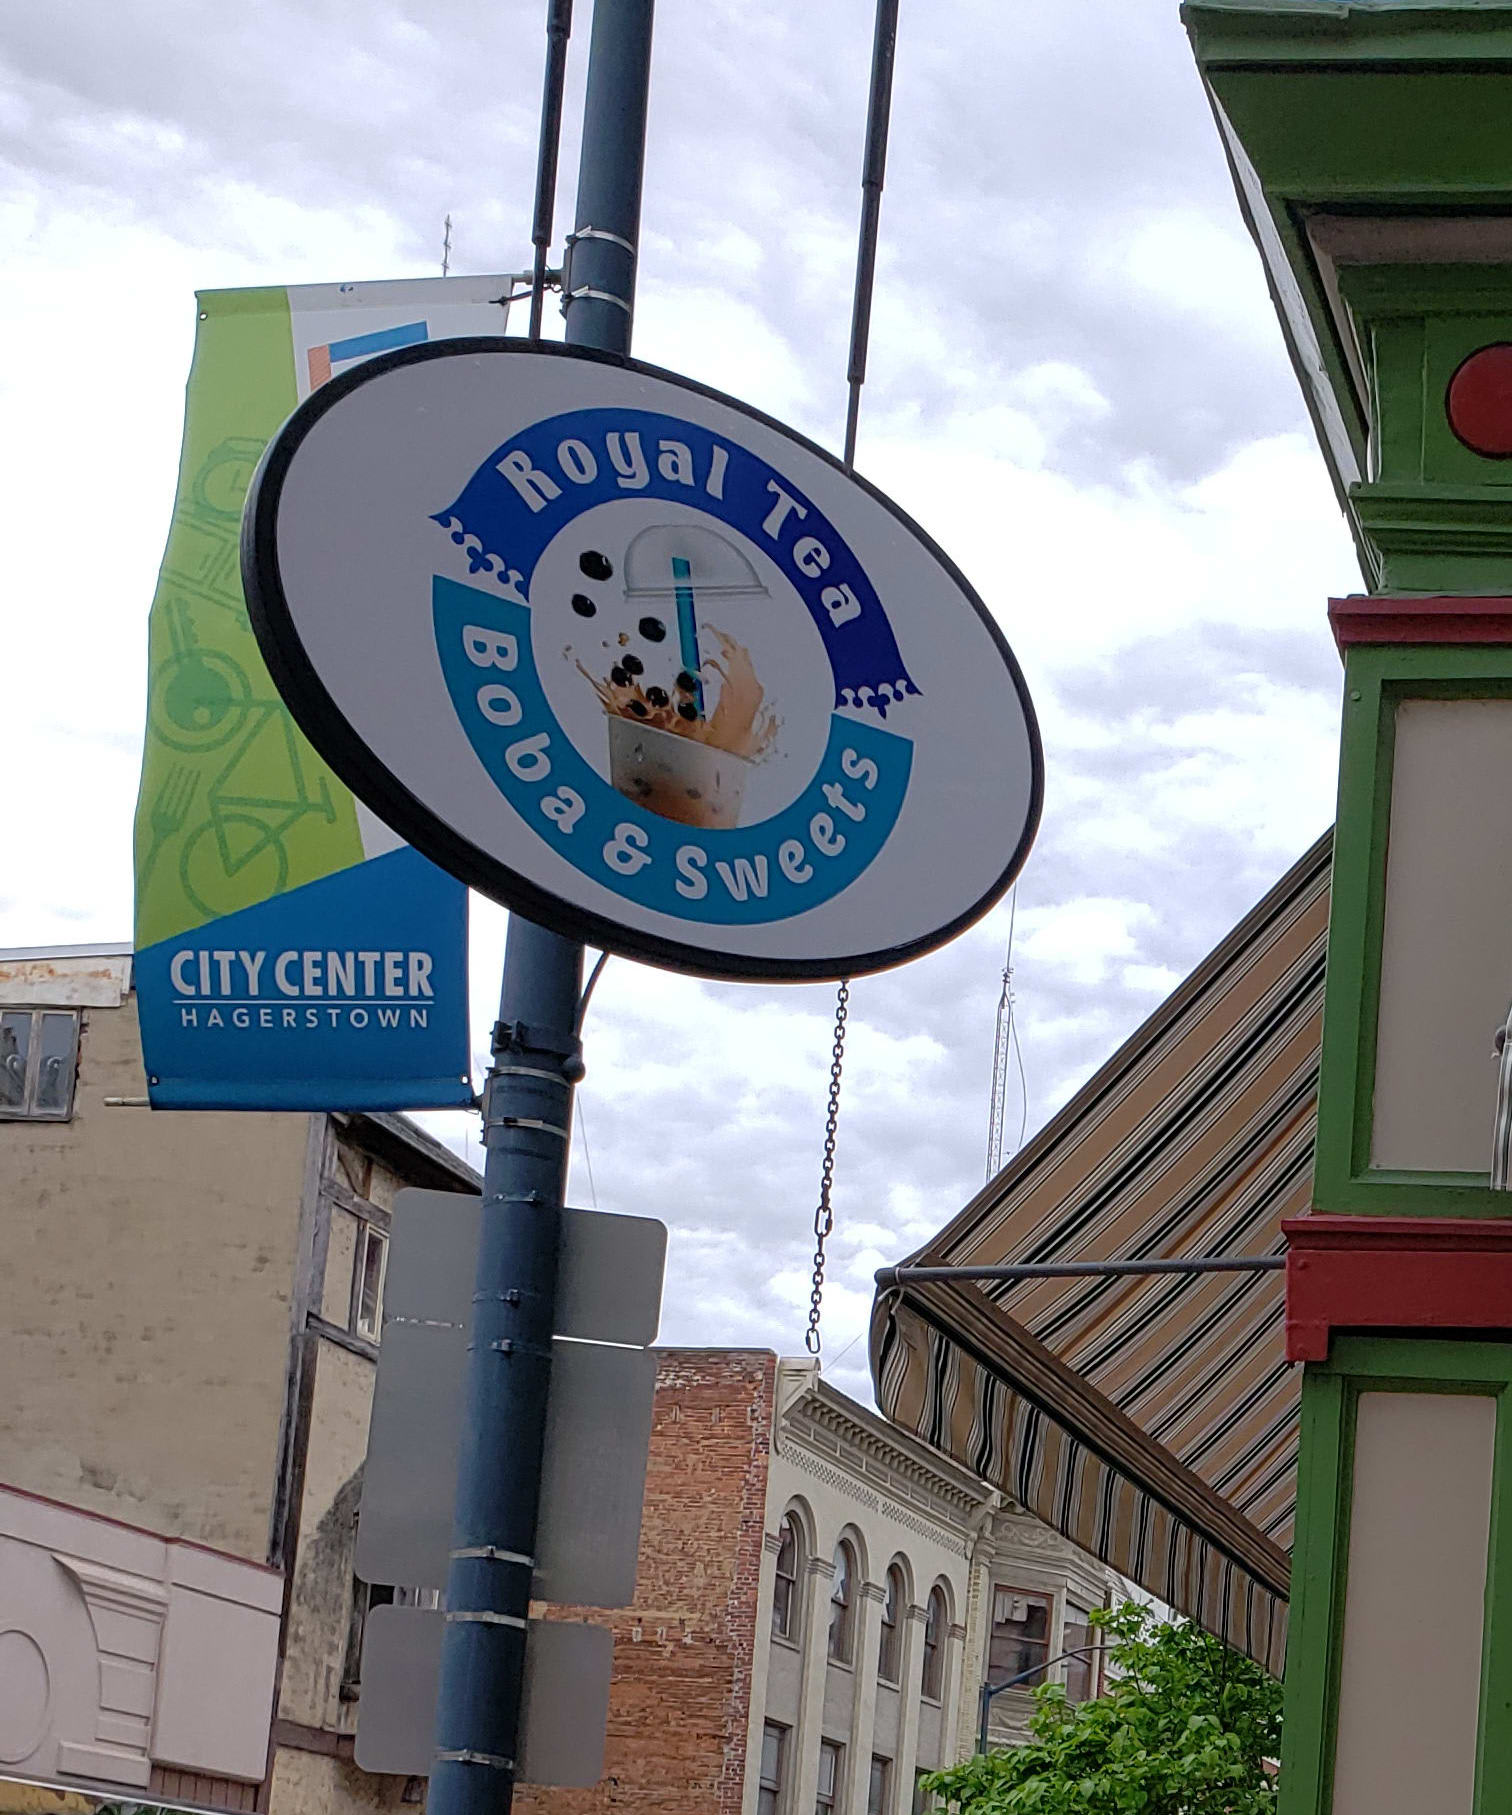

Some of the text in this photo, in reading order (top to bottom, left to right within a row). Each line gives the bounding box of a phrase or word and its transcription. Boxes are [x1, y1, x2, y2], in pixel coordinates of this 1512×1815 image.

[497, 430, 861, 630] Royal Tea
[461, 623, 881, 902] Boba & Sweets
[170, 949, 435, 999] CITY CENTER
[181, 1007, 430, 1030] HAGERSTOWN
